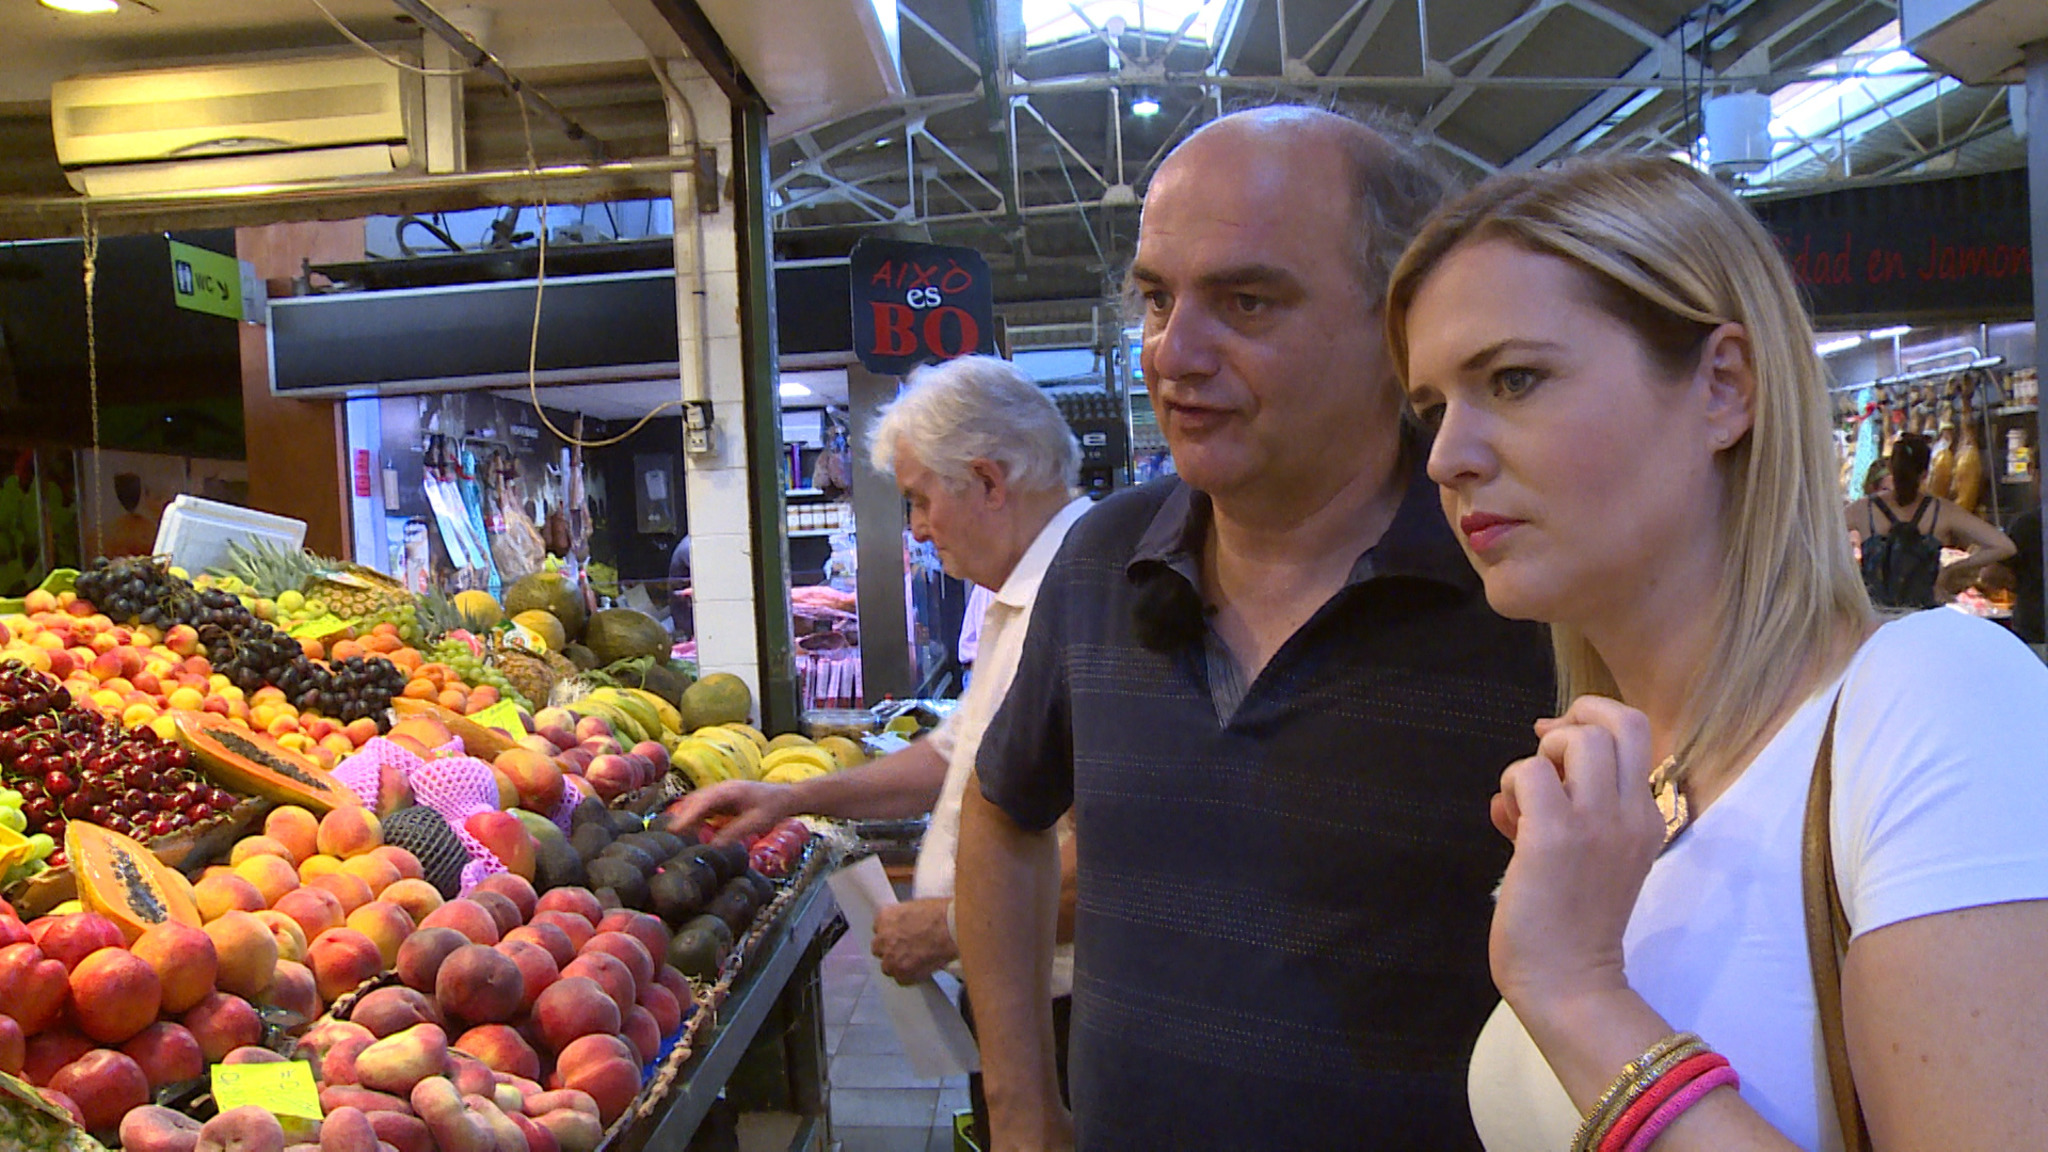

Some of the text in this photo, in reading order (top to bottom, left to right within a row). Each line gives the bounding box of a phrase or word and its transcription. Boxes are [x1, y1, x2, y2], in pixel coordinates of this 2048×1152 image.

[871, 258, 973, 294] AIXÒ
[1866, 247, 1906, 284] en
[1917, 234, 2031, 282] Jamon
[195, 272, 214, 293] WC
[906, 286, 942, 309] es
[869, 301, 979, 360] BO
